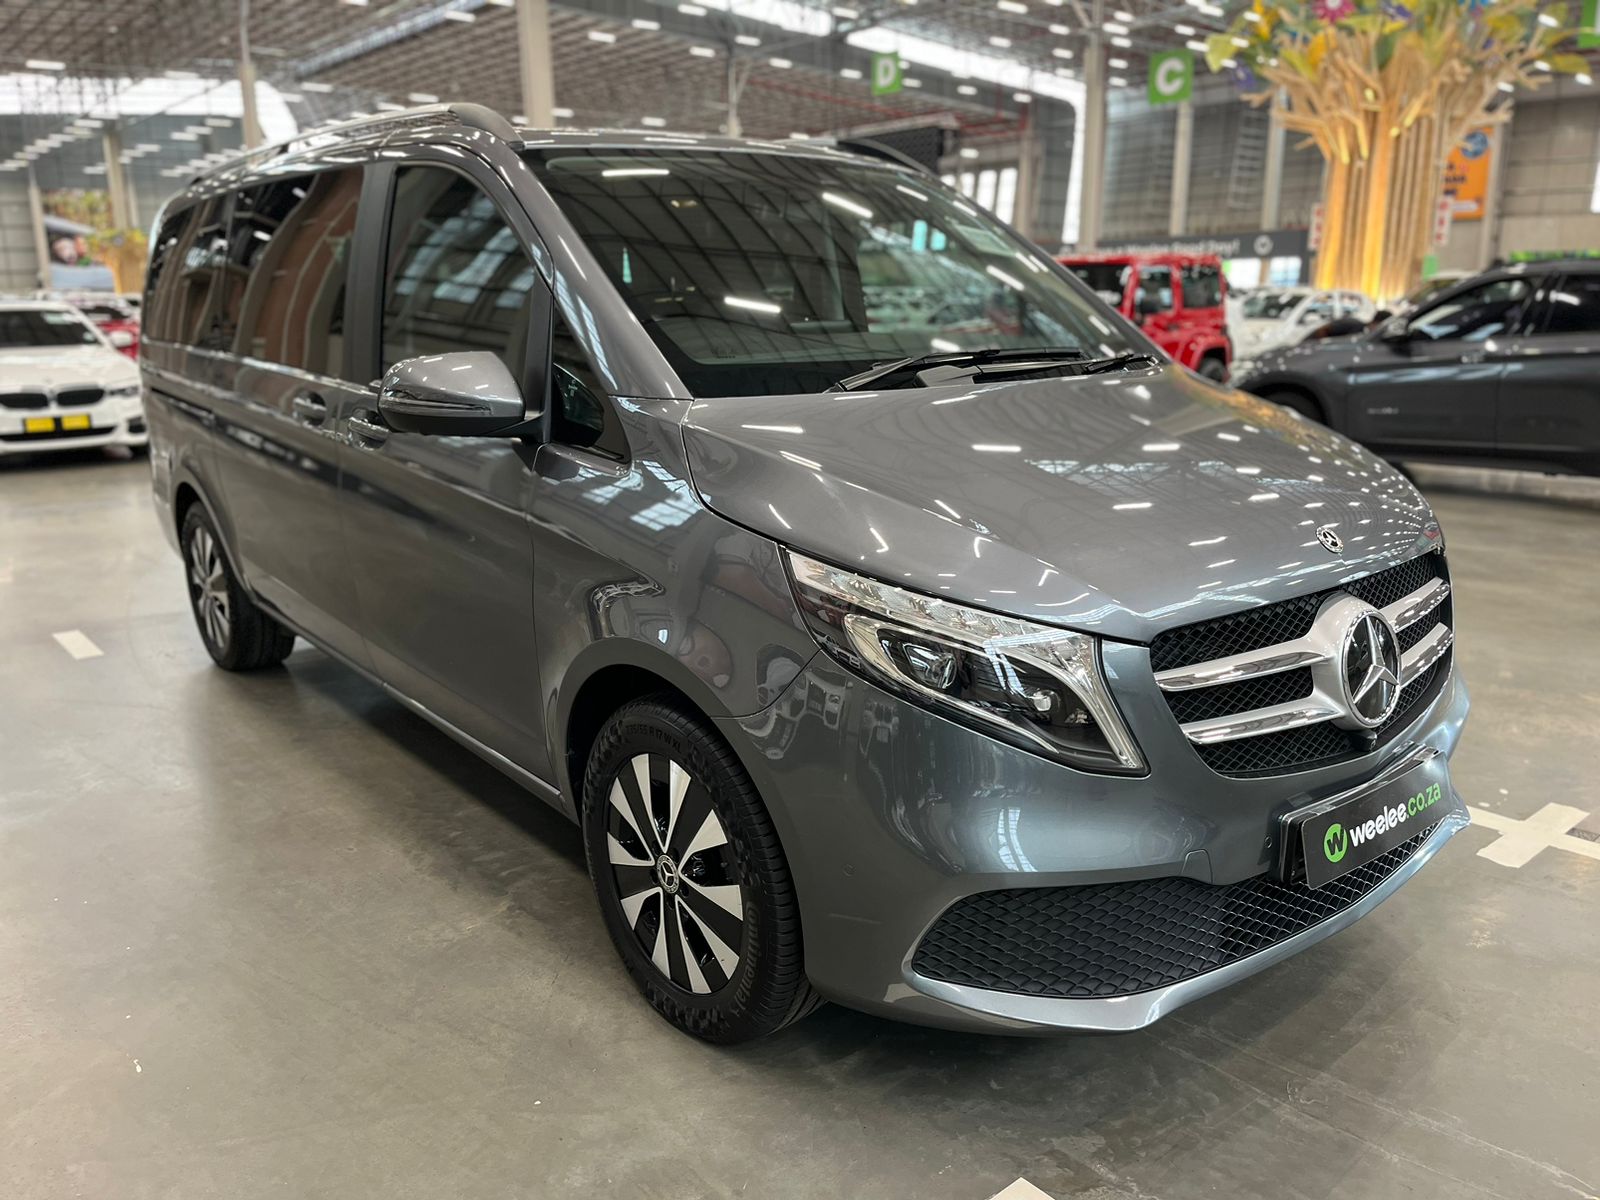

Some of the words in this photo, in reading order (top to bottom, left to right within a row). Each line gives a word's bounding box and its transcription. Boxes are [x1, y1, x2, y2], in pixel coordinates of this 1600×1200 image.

[878, 58, 897, 87] D
[1156, 57, 1184, 95] C
[1350, 782, 1441, 847] weelee.co.za
[734, 901, 761, 1010] Continental
